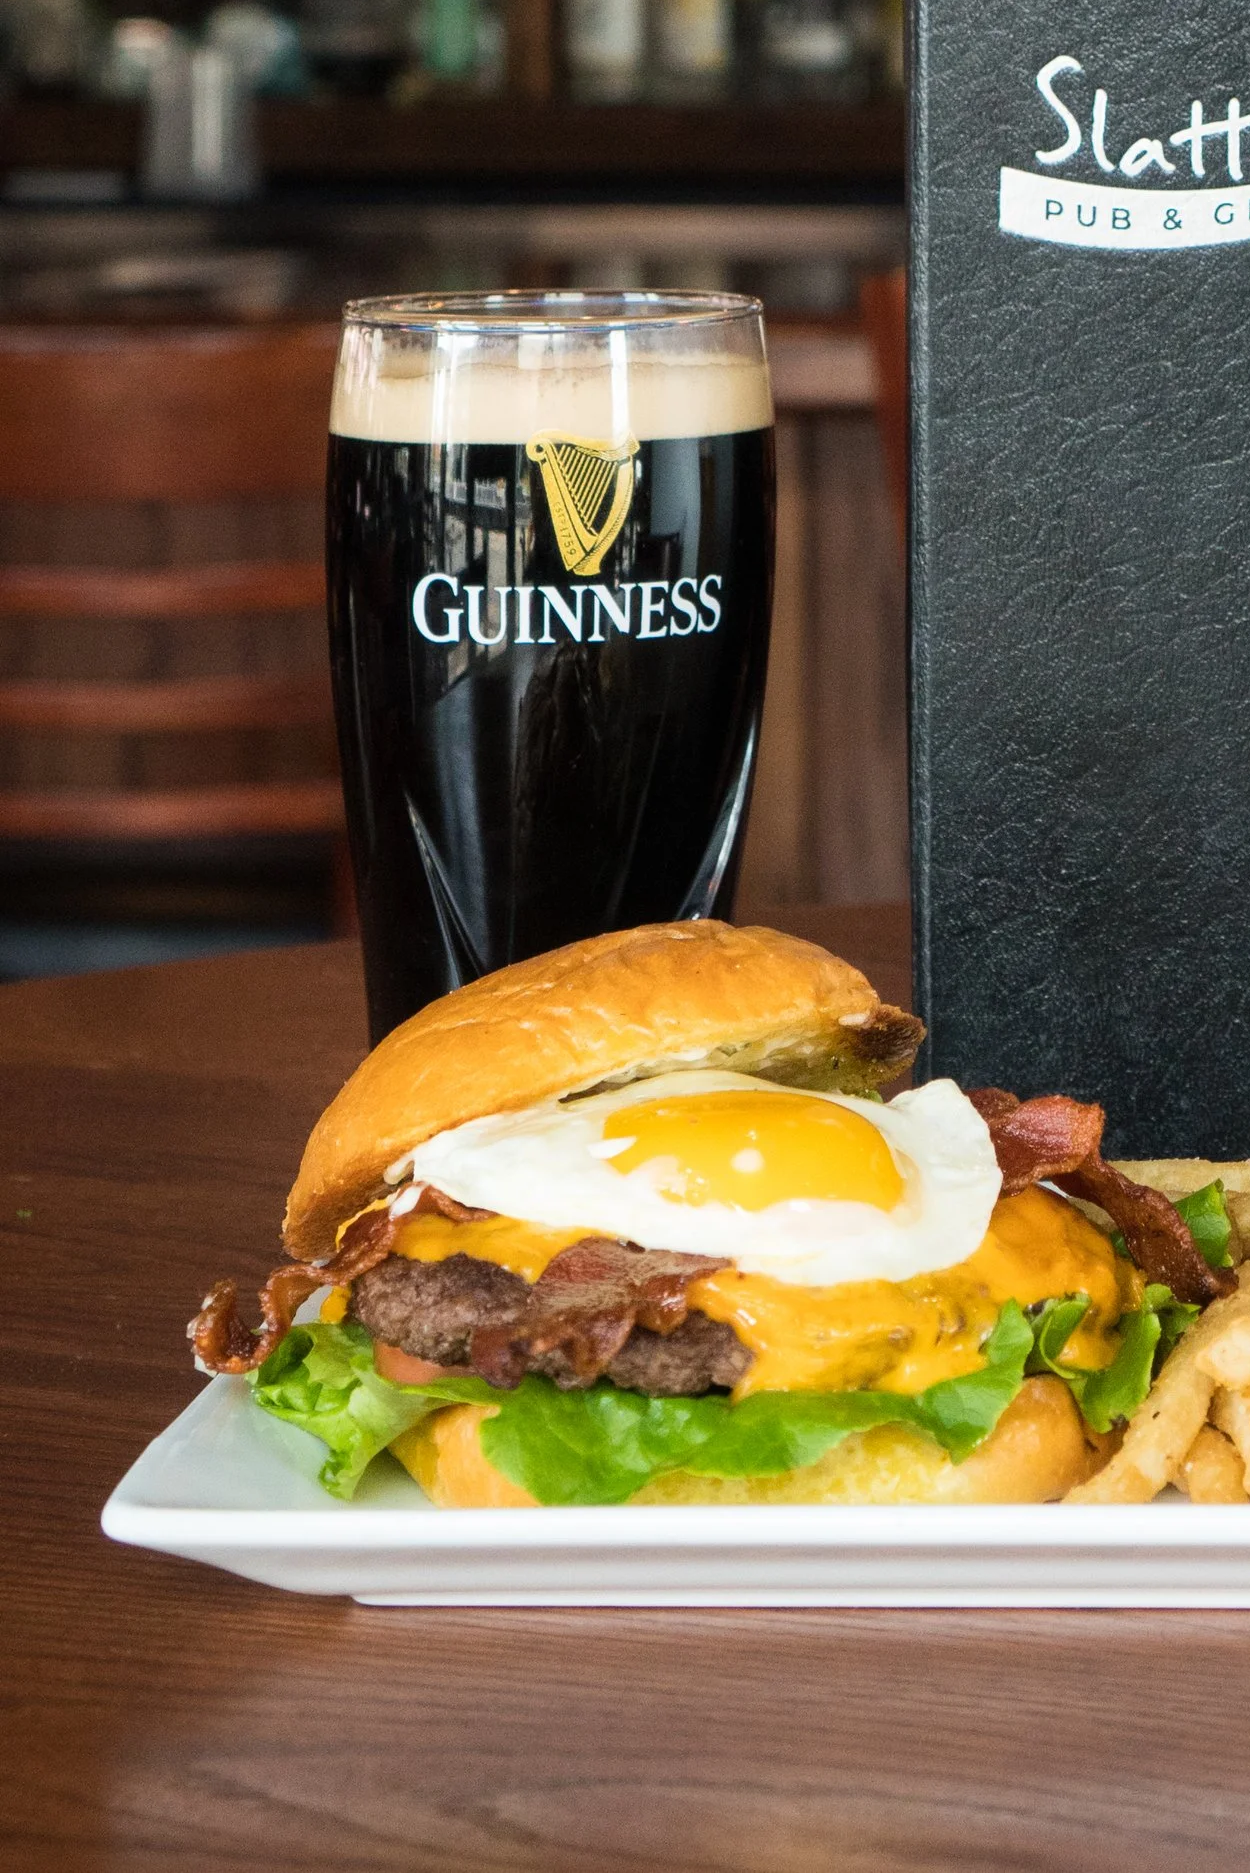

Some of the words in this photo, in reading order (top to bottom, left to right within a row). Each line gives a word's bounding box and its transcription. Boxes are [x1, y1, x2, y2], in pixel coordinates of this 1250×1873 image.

[1044, 198, 1131, 230] PUB
[1162, 208, 1183, 230] &
[412, 573, 722, 645] GUINNESS
